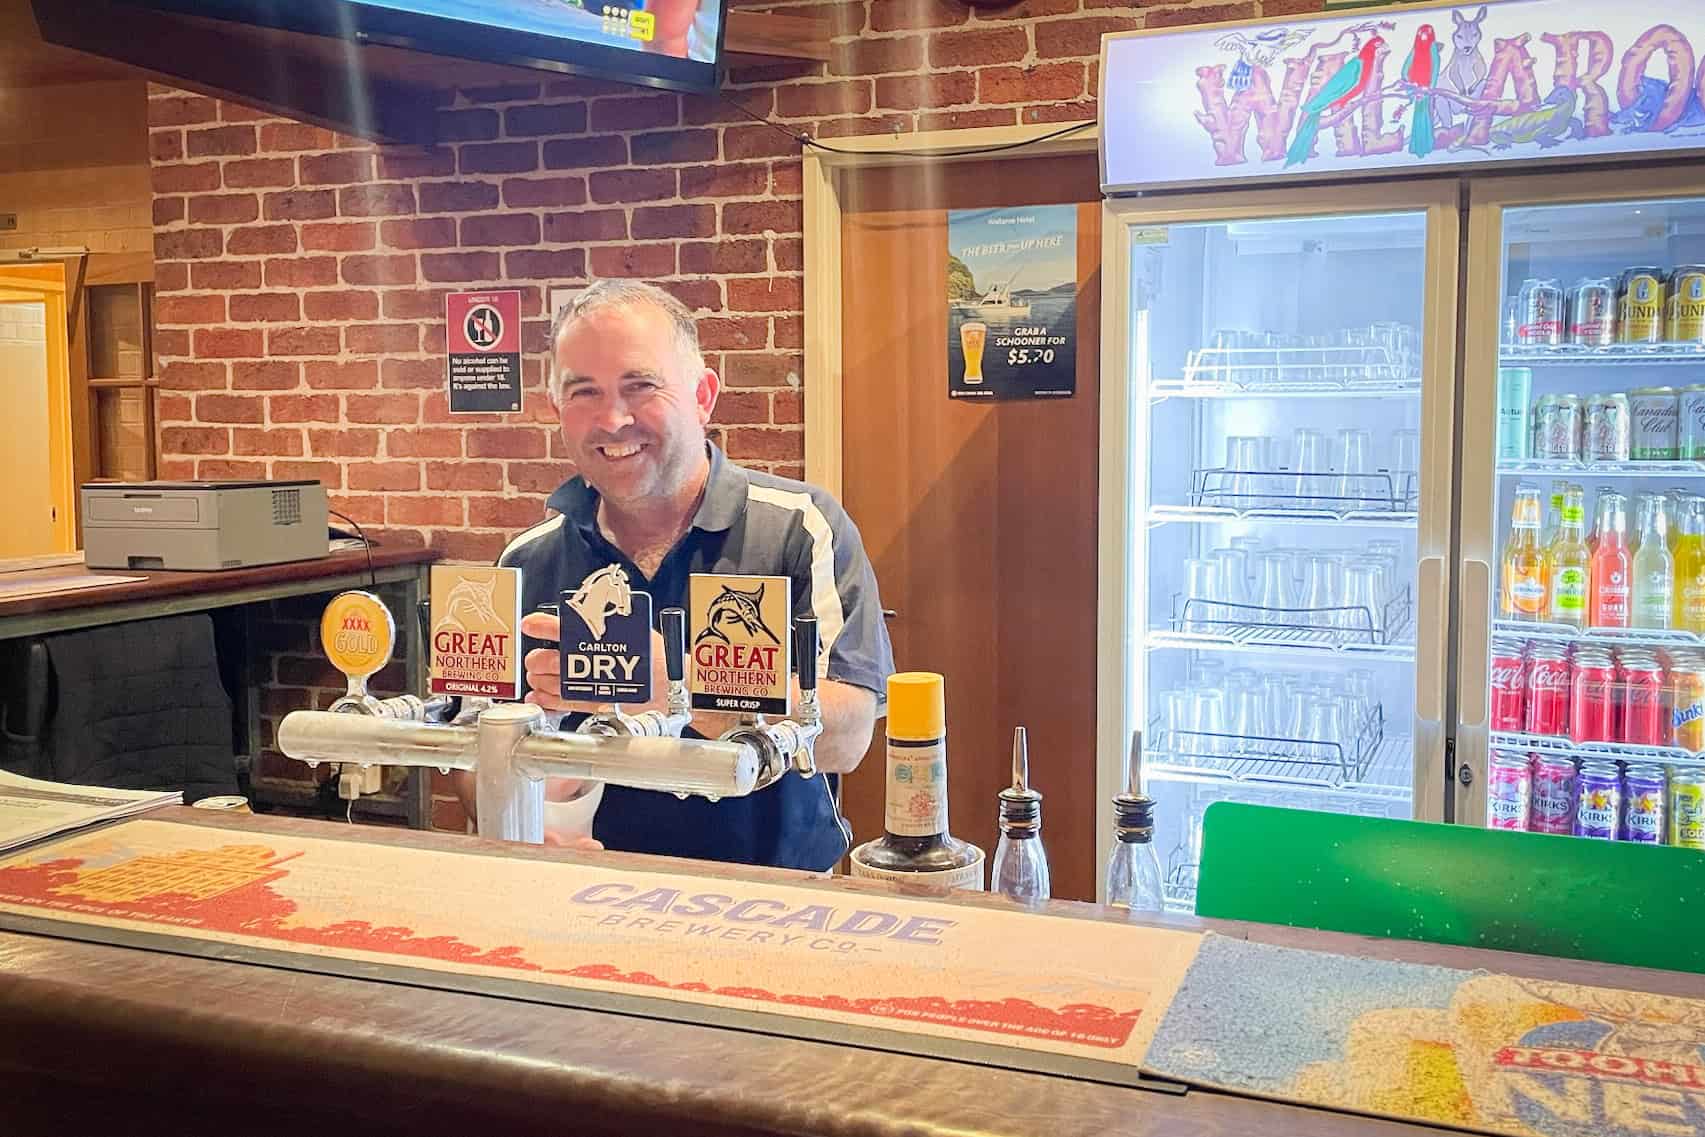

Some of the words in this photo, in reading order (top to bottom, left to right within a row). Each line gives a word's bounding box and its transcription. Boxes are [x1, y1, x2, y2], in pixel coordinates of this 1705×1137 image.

[1014, 328, 1039, 336] GRAB
[995, 337, 1046, 346] SCHOONER
[1047, 337, 1066, 345] FOR
[342, 618, 370, 632] XXXX
[335, 631, 378, 655] GOLD
[434, 632, 509, 656] GREAT
[578, 641, 627, 653] CARLTON
[435, 655, 507, 672] NORTHERN
[695, 644, 779, 670] GREAT
[567, 654, 641, 681] DRY
[442, 670, 482, 681] BREWING
[697, 669, 776, 686] NORTHERN
[445, 682, 479, 692] ORIGINAL
[704, 684, 749, 696] BREWING
[716, 698, 739, 709] SUPER
[740, 699, 761, 710] CRISP
[1533, 798, 1569, 811] KIRKS
[569, 884, 959, 946] CASCADE
[597, 914, 802, 947] BREWERY
[895, 1008, 920, 1017] FOR
[920, 1011, 968, 1024] PEOPLE
[968, 1018, 1001, 1027] OVER
